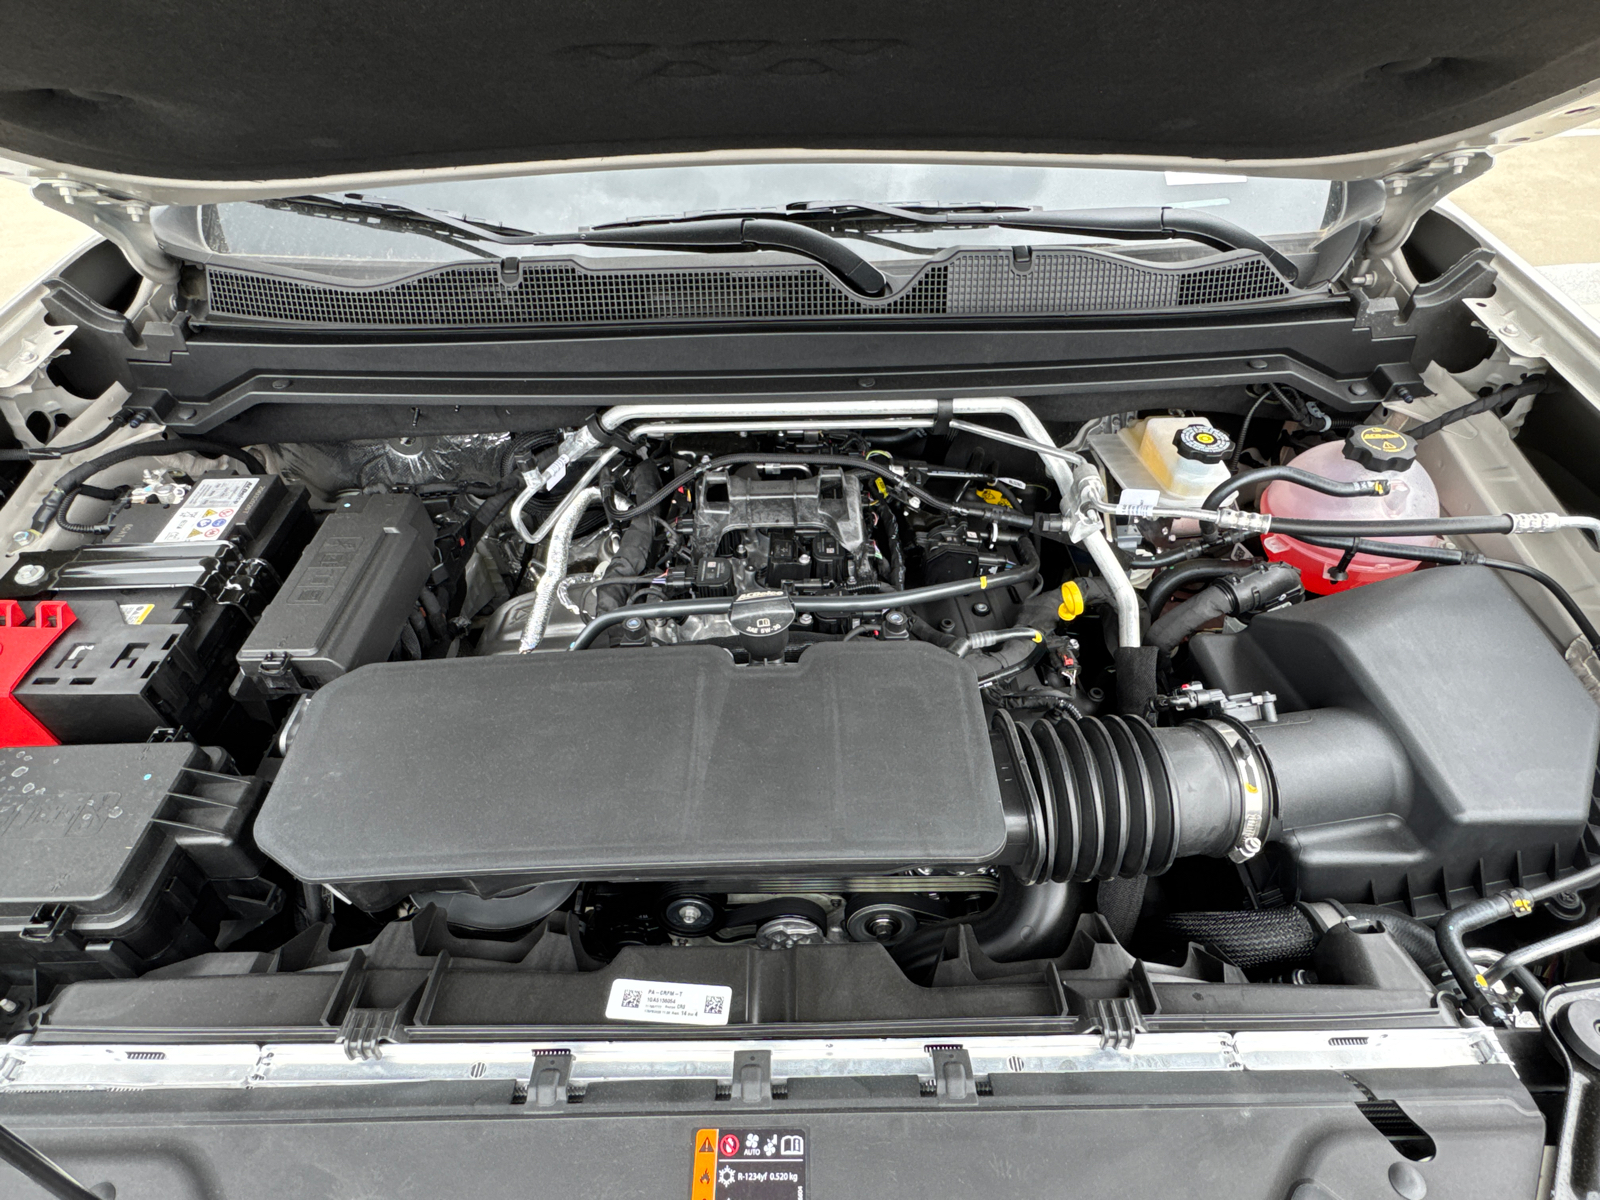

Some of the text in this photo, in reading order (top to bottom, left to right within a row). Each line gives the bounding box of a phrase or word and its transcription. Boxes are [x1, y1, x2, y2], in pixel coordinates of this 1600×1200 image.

[735, 590, 784, 602] ACDelco
[745, 623, 782, 634] SAE 5W-30
[737, 1171, 798, 1183] R-1234yf 0.520 kg
